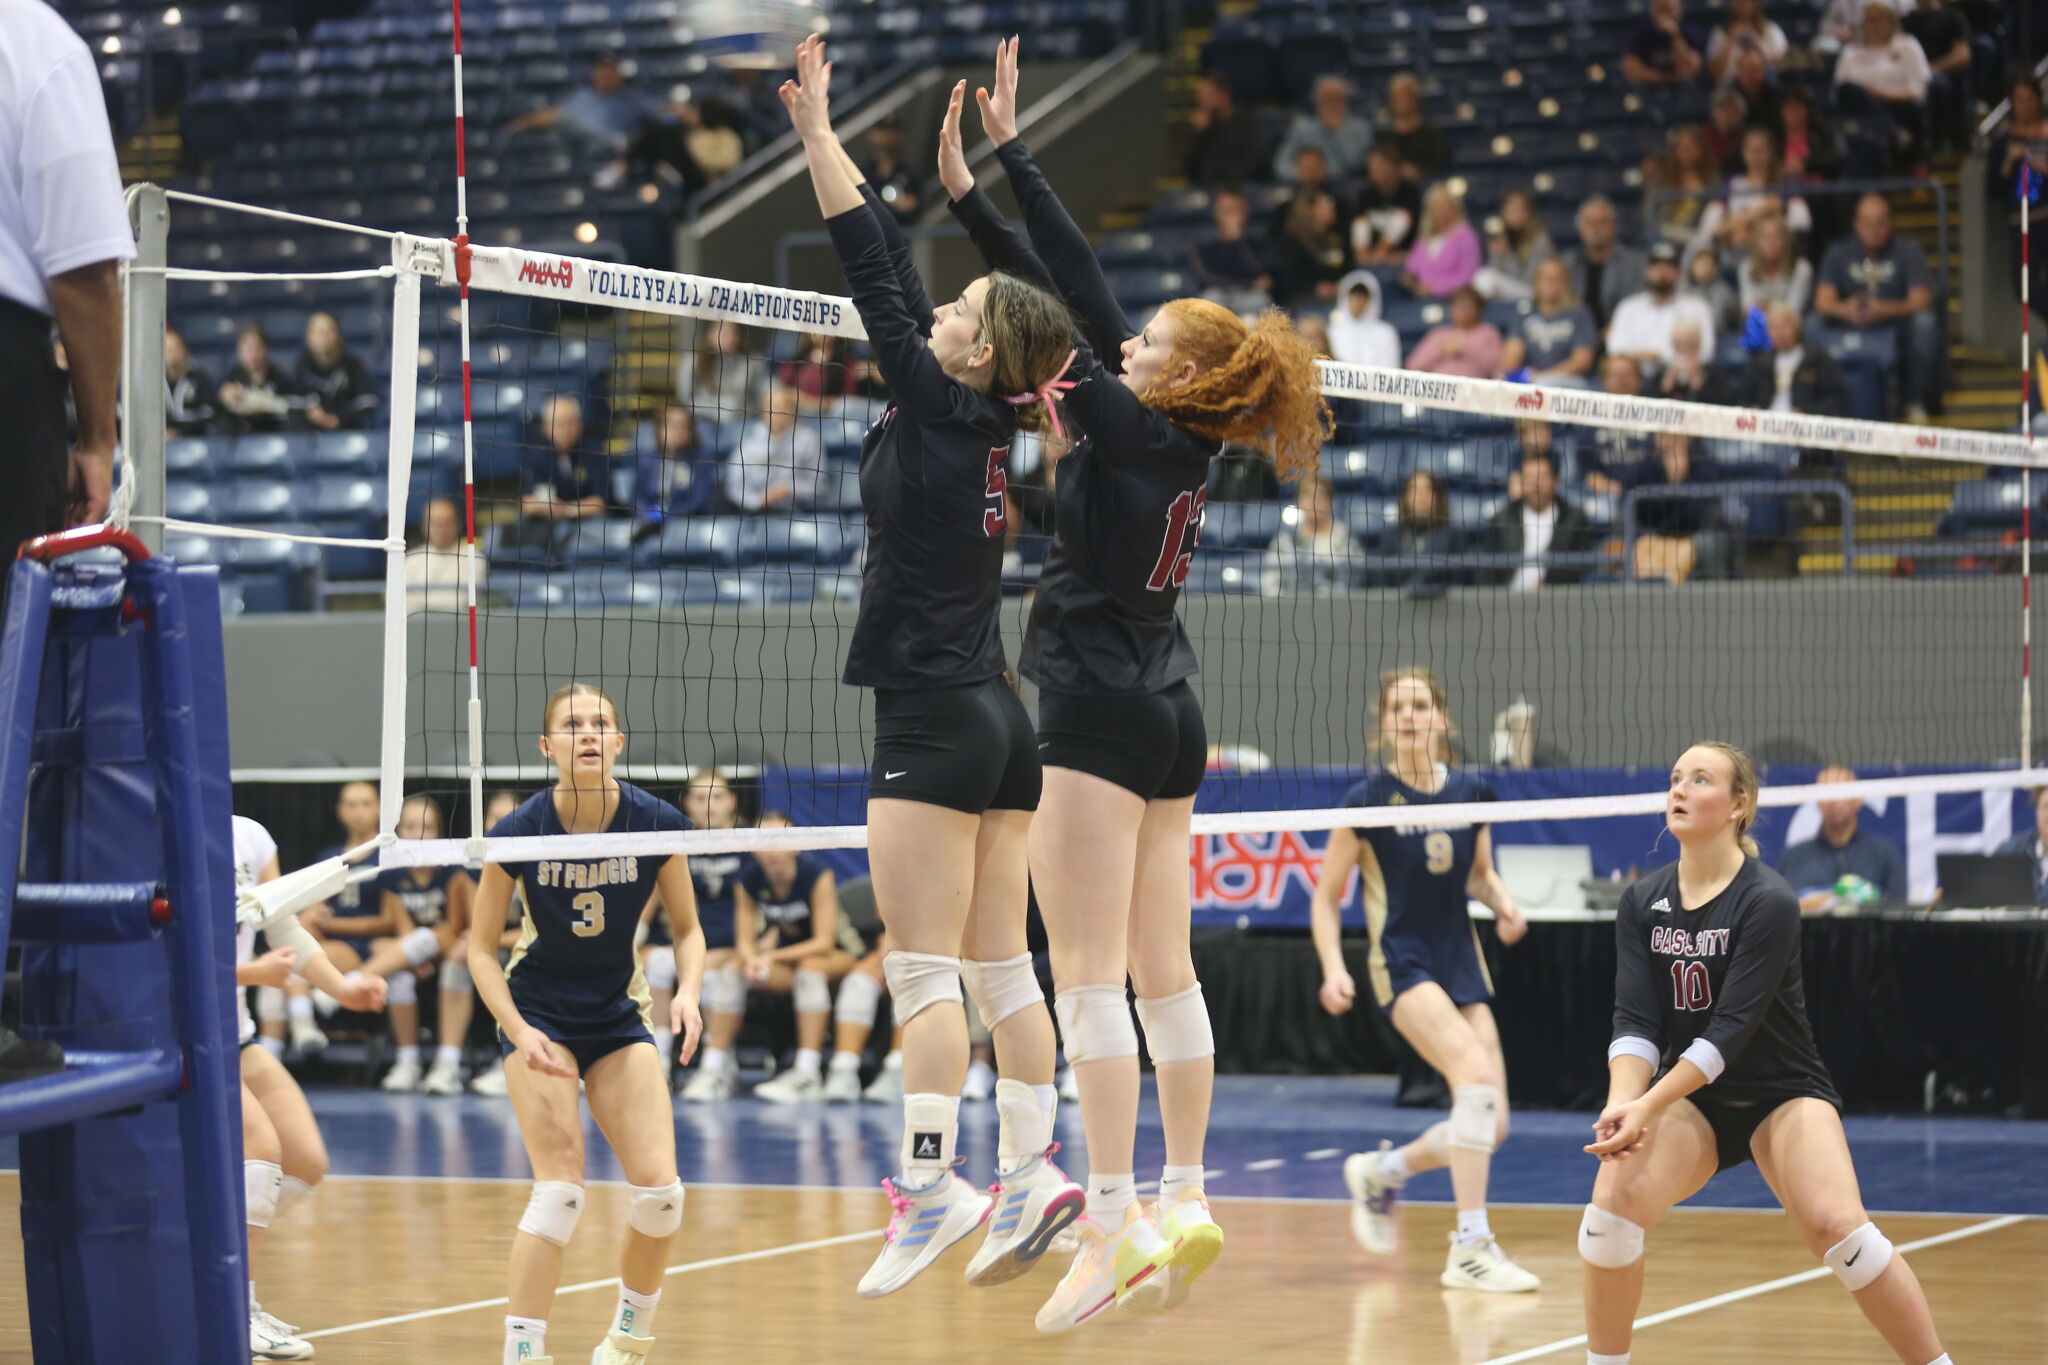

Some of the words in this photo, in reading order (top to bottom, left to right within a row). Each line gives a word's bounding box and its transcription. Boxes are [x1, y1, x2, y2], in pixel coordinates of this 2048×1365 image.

[588, 269, 703, 306] VOLLEYBALL
[708, 286, 841, 326] CHAMPIONSHIPS
[983, 444, 1009, 537] 5
[537, 861, 562, 887] ST
[564, 856, 639, 889] FRANCIS
[1425, 831, 1455, 875] 9
[571, 890, 605, 937] 3
[1671, 960, 1712, 1012] 10
